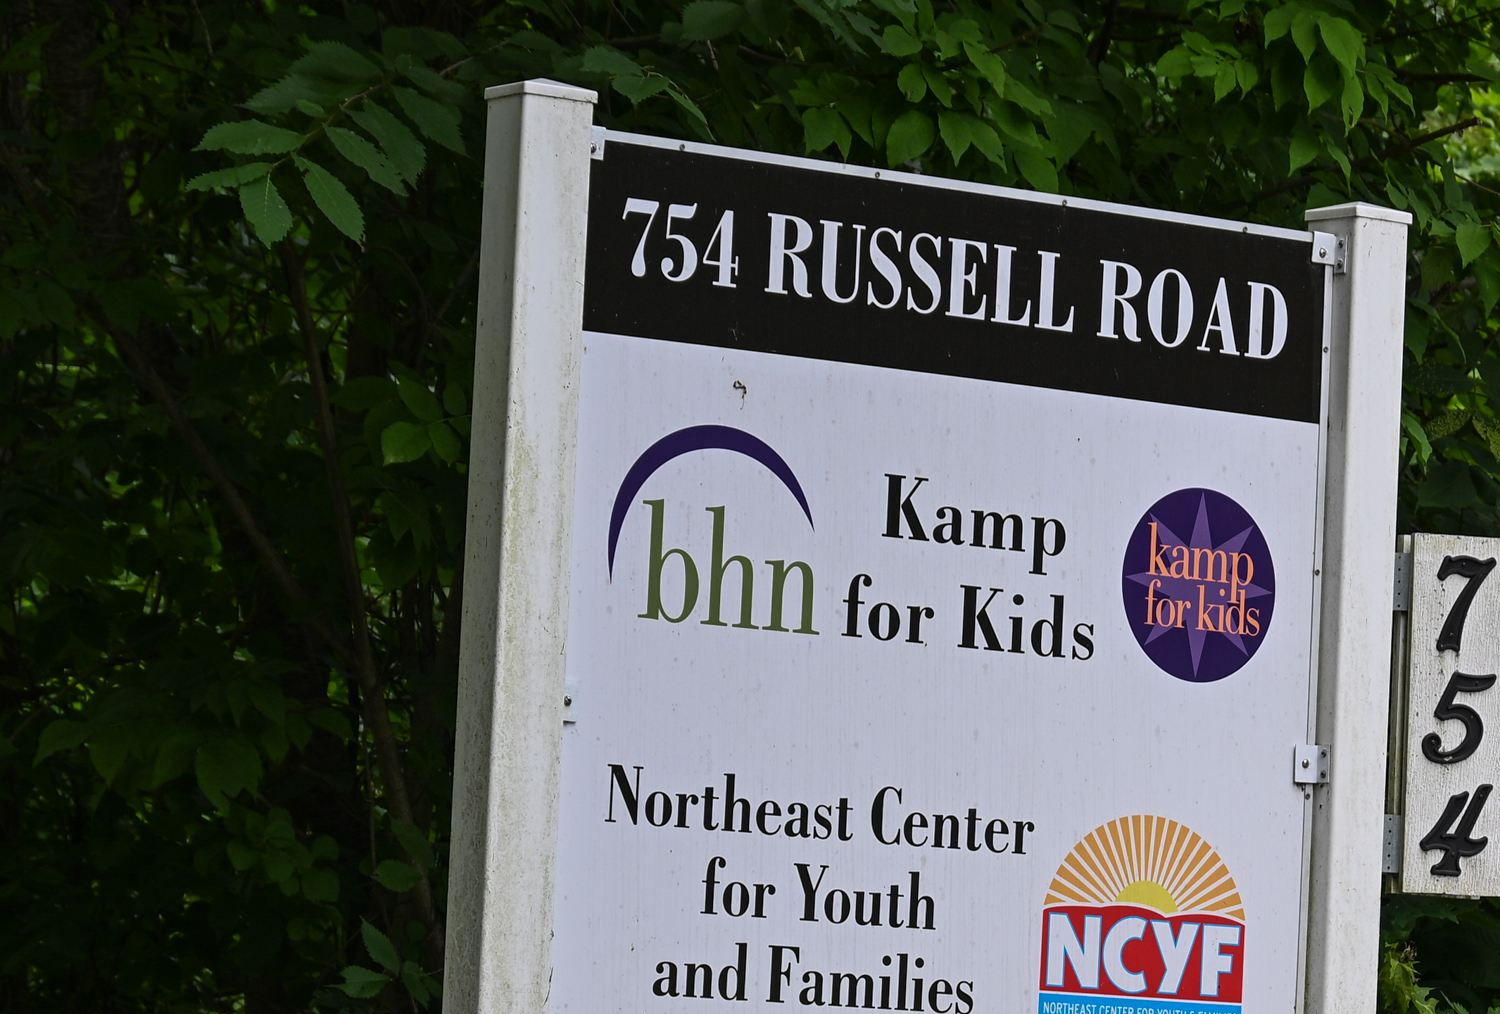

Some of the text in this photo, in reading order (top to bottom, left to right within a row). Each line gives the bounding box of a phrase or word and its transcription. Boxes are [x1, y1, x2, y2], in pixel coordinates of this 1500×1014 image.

[621, 196, 1288, 360] 754 RUSSELL ROAD
[637, 498, 820, 636] bhn
[881, 473, 1066, 575] Kamp
[1146, 521, 1254, 604] kamp
[841, 573, 1096, 661] for Kids
[1144, 578, 1261, 637] for kids
[604, 763, 1035, 855] Northeast Center
[700, 856, 936, 930] for Youth
[652, 943, 748, 1002] and
[1045, 911, 1241, 997] NCYF
